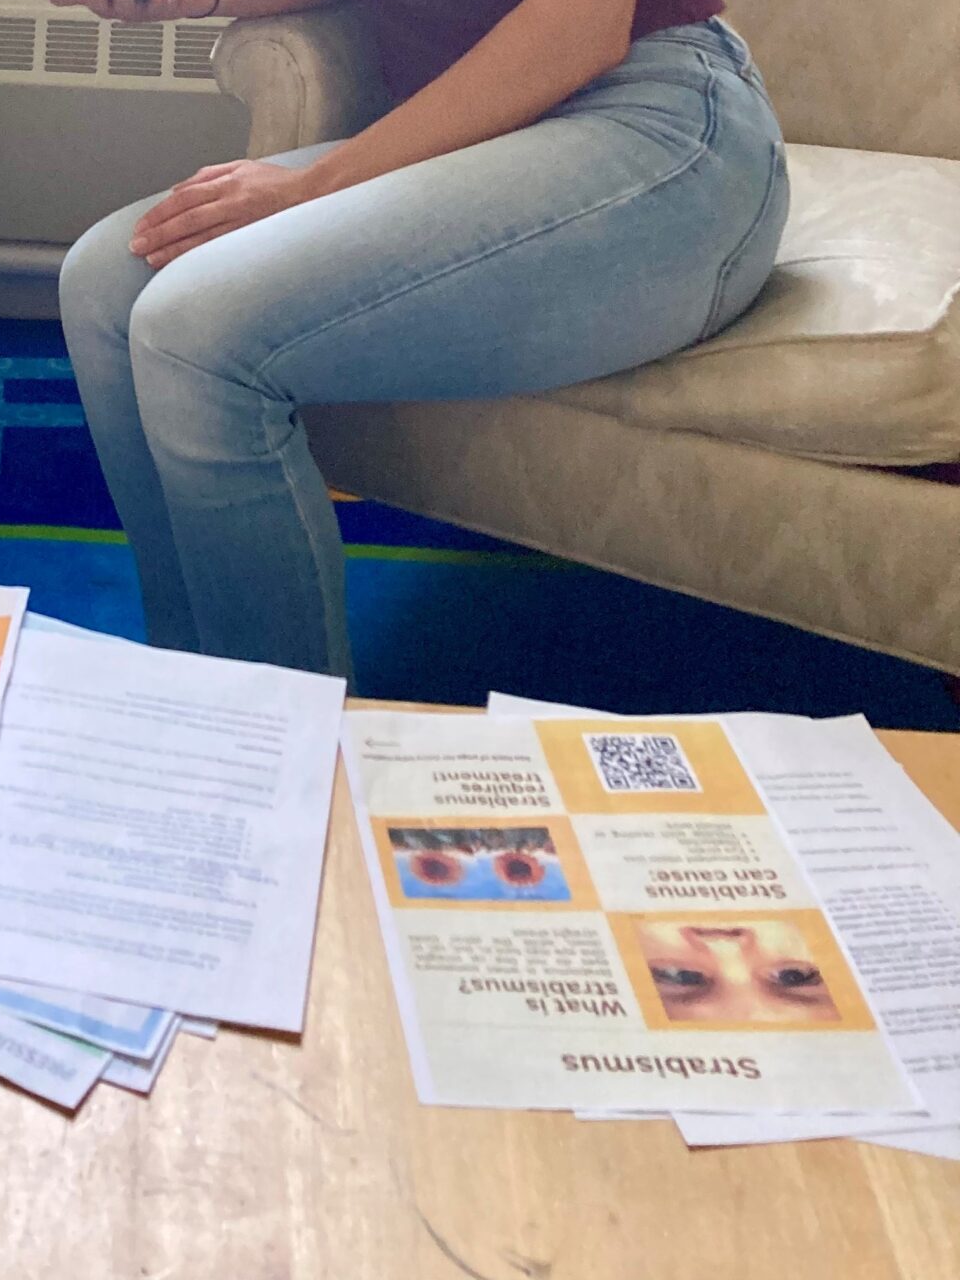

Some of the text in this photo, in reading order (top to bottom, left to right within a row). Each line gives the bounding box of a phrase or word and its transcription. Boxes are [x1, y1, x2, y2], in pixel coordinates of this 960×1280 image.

[432, 771, 541, 783] treatment!
[460, 783, 545, 797] requires
[433, 794, 551, 809] Strabismus
[648, 869, 778, 883] can cause:
[645, 883, 787, 901] Strabismus
[458, 977, 619, 999] strabismus?
[526, 998, 627, 1018] What is
[561, 1053, 762, 1080] Strabismus
